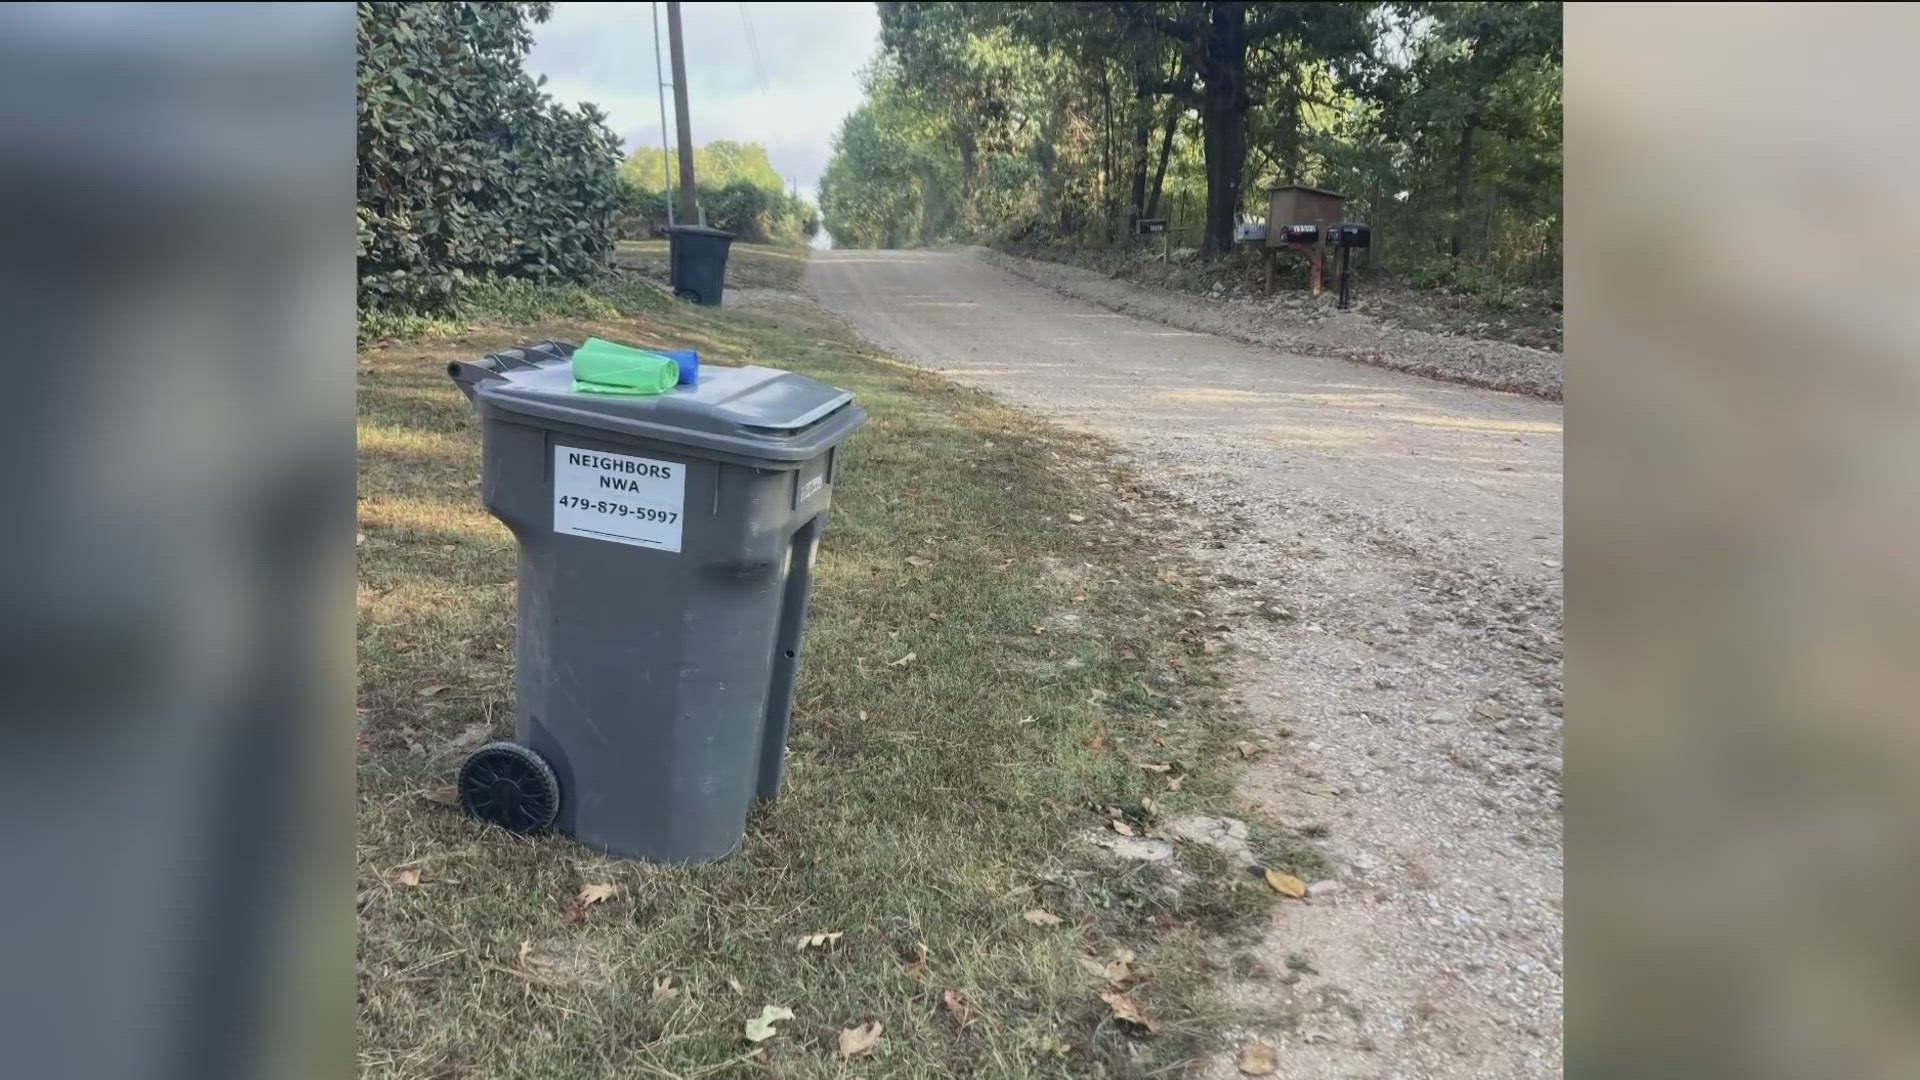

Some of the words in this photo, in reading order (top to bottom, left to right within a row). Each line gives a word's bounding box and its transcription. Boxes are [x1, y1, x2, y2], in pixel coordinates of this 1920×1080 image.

[569, 453, 671, 479] NEIGHBORS
[600, 475, 640, 493] NWA
[559, 495, 678, 524] 479-879-5997
